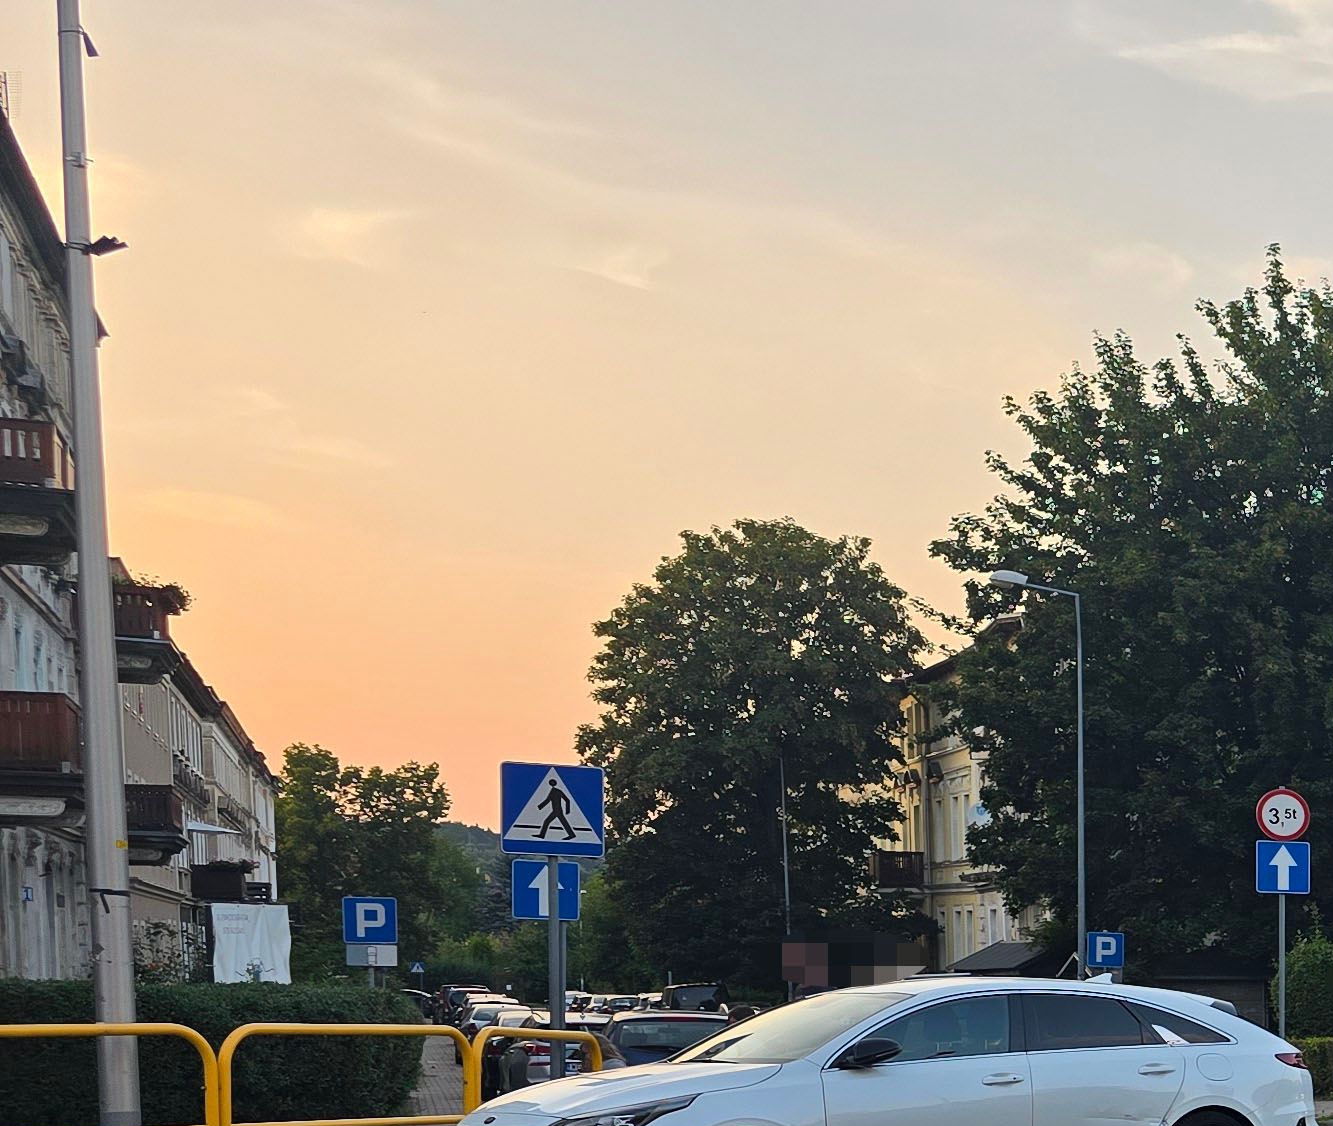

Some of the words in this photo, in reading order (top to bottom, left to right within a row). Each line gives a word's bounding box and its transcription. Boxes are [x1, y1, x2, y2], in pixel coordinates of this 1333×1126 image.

[1269, 808, 1297, 828] 3,5t
[356, 902, 385, 937] P
[1096, 936, 1116, 962] P
